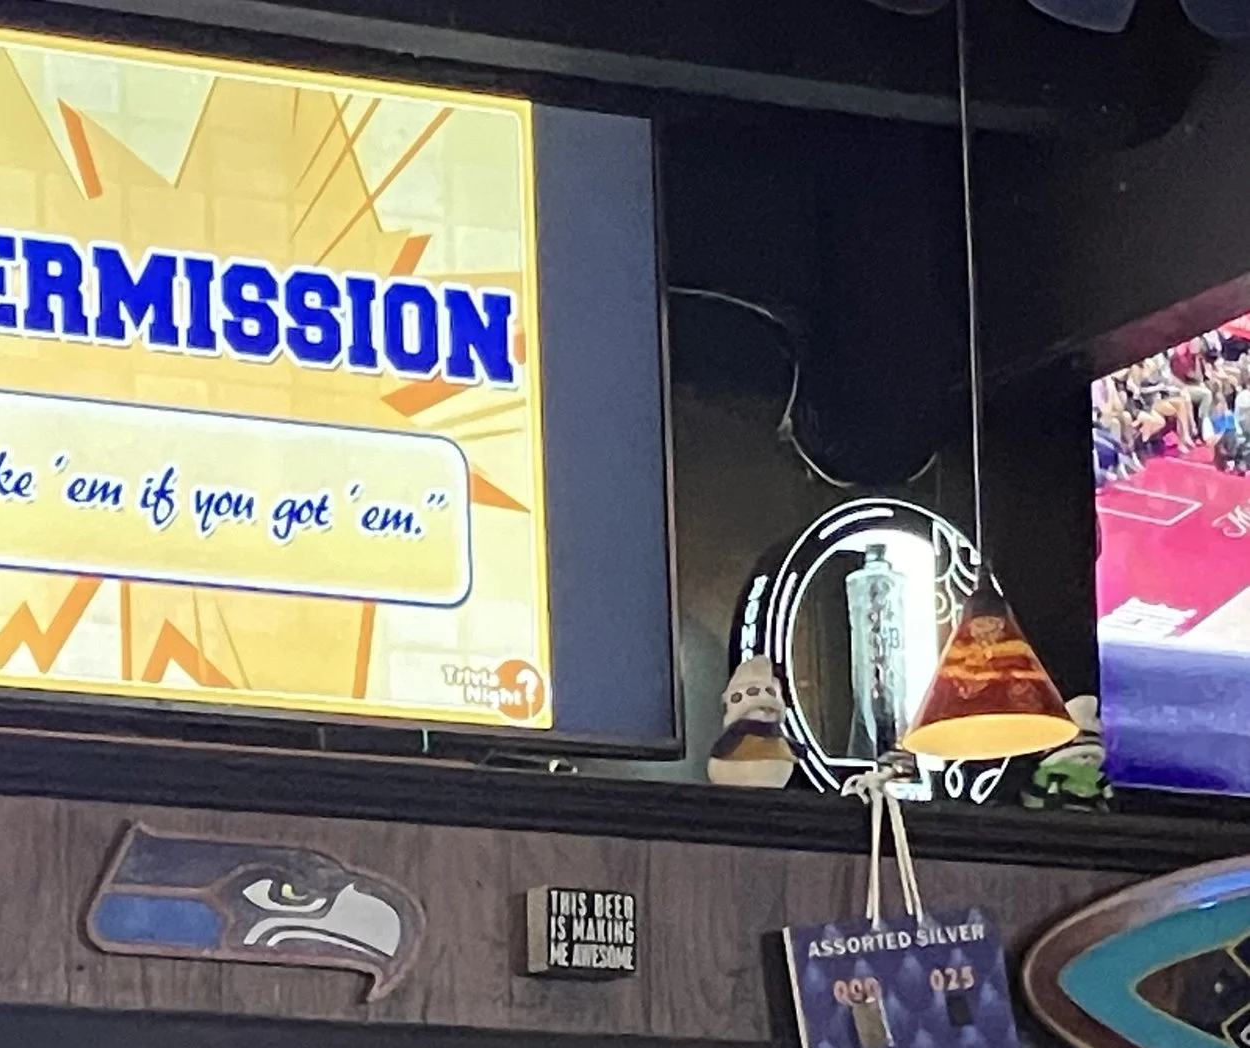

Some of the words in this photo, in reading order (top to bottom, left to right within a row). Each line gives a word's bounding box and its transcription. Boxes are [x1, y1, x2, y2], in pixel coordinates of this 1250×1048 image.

[54, 454, 123, 506] 'em
[140, 466, 175, 525] if
[194, 489, 254, 533] you
[272, 494, 329, 539] got
[441, 664, 500, 688] Trivia
[550, 889, 588, 917] THIS
[594, 892, 635, 919] BEER
[550, 915, 567, 940] IS
[572, 917, 635, 945] MAKING
[808, 931, 912, 958] ASSORTED
[914, 923, 985, 948] SILVER
[549, 941, 570, 967] ME
[572, 943, 635, 970] AWESOME
[929, 965, 975, 992] 025
